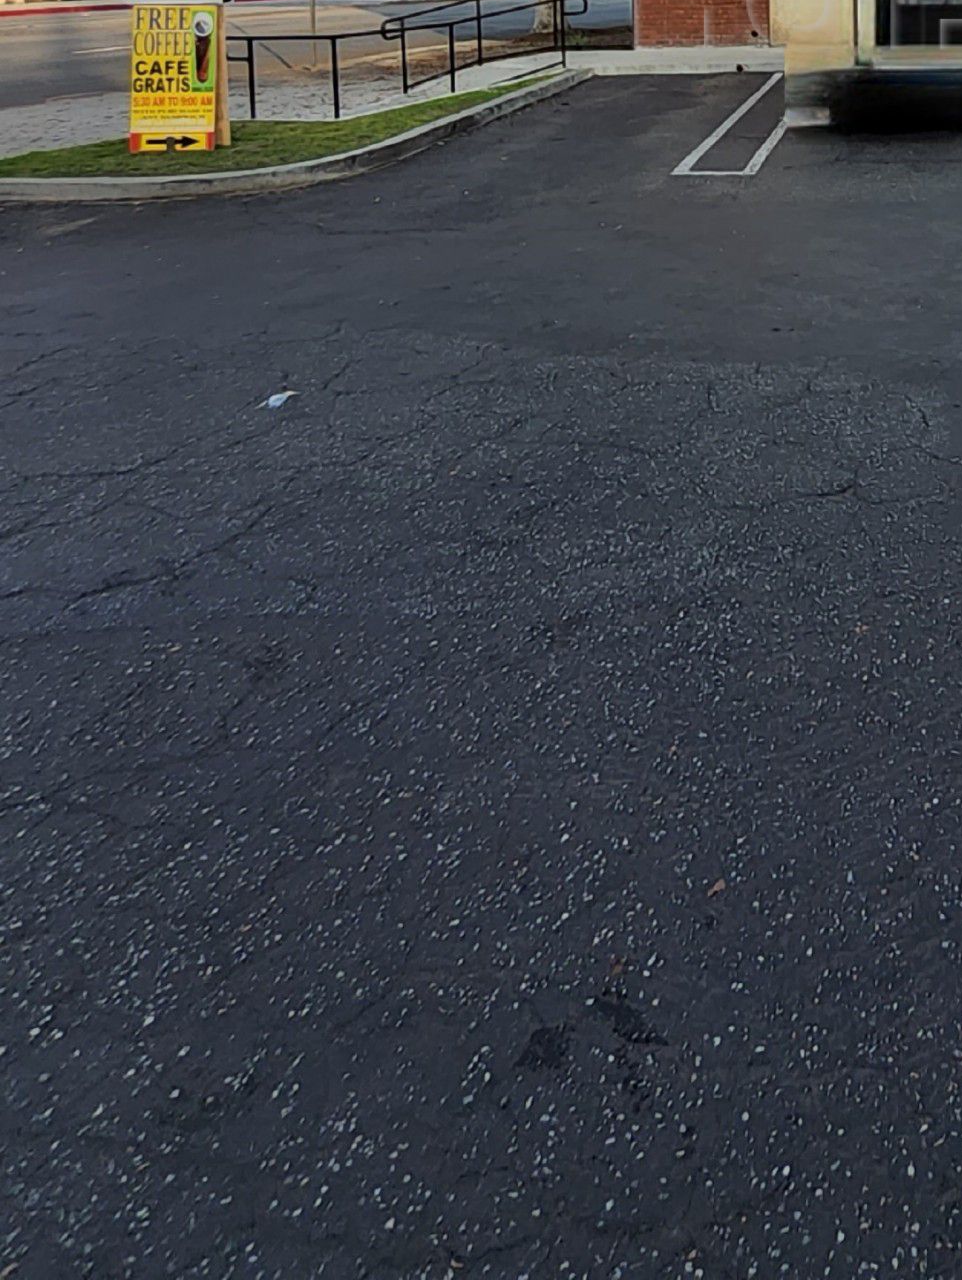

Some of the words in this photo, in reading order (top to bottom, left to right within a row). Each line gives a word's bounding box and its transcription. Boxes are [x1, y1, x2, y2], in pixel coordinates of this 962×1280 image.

[135, 6, 190, 30] FREE
[133, 31, 192, 57] COFFEE
[135, 60, 190, 76] CAFE
[133, 77, 191, 94] GRATIS
